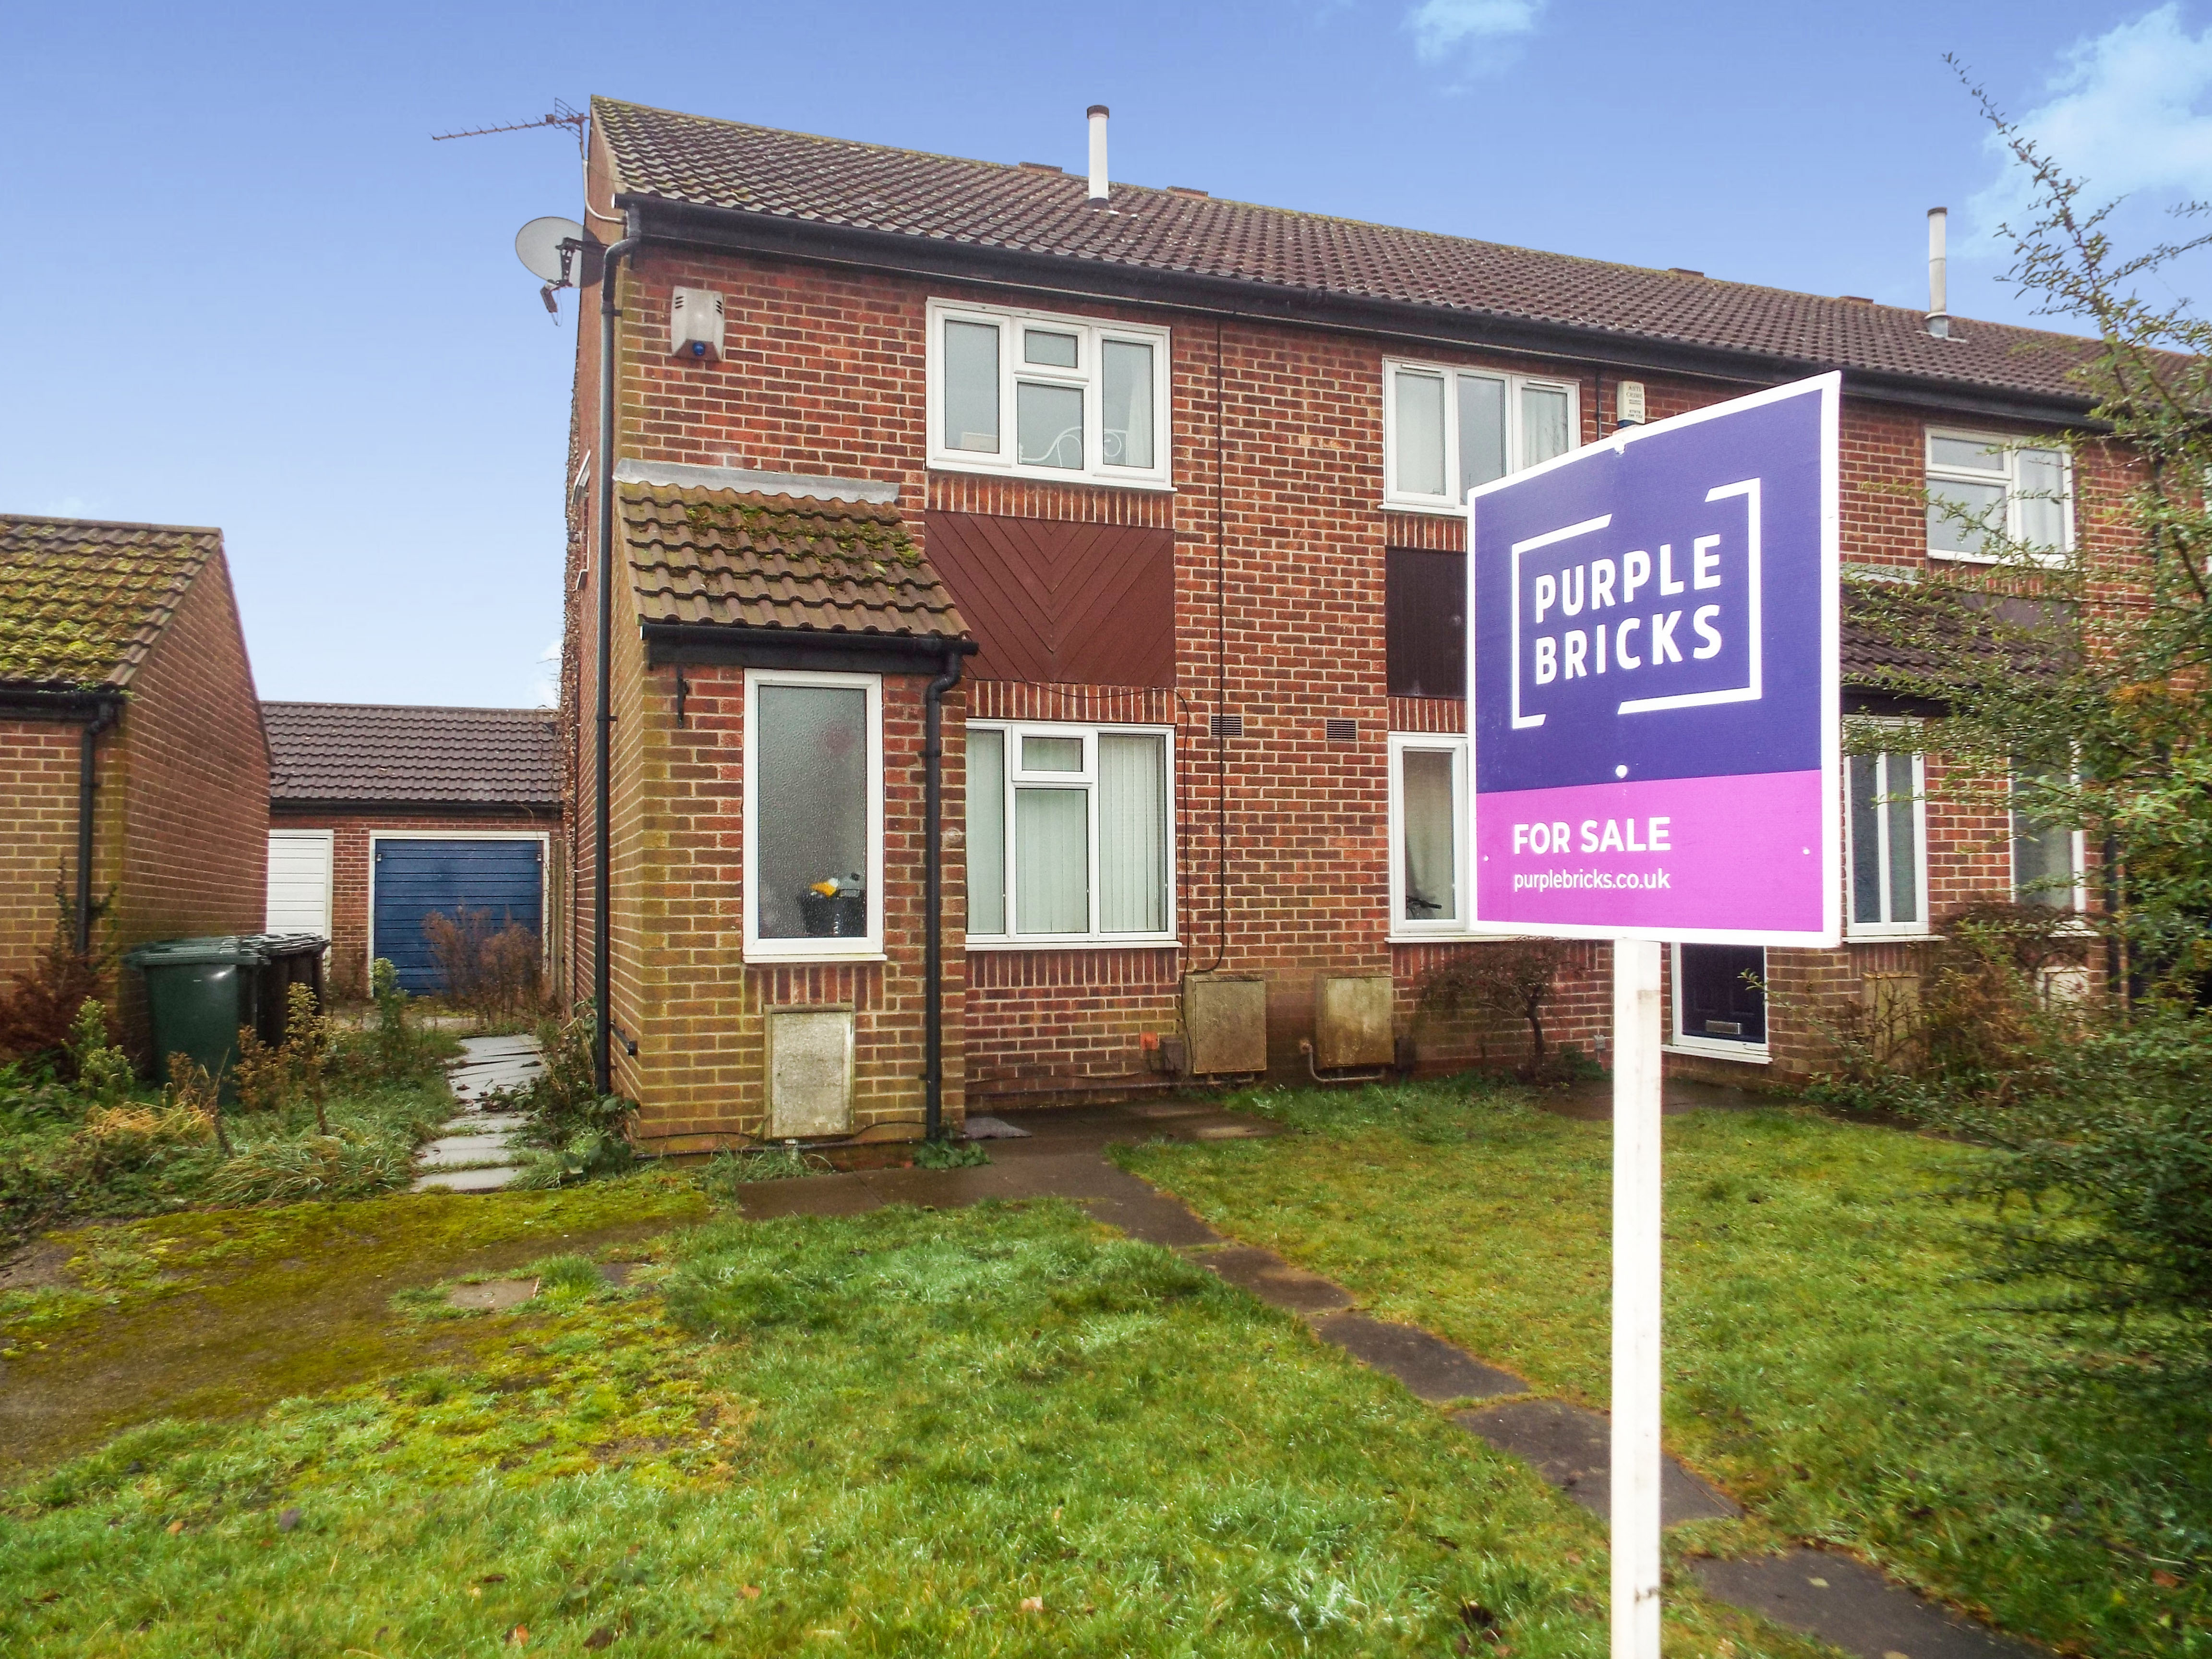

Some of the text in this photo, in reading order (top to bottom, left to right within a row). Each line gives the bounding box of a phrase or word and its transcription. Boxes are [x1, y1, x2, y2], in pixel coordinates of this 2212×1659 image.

[1535, 533, 1722, 625] PURPLE
[1535, 604, 1722, 685] BRICKS
[1513, 816, 1672, 854] FOR SALE
[1514, 867, 1671, 892] purplebricks.co.uk
